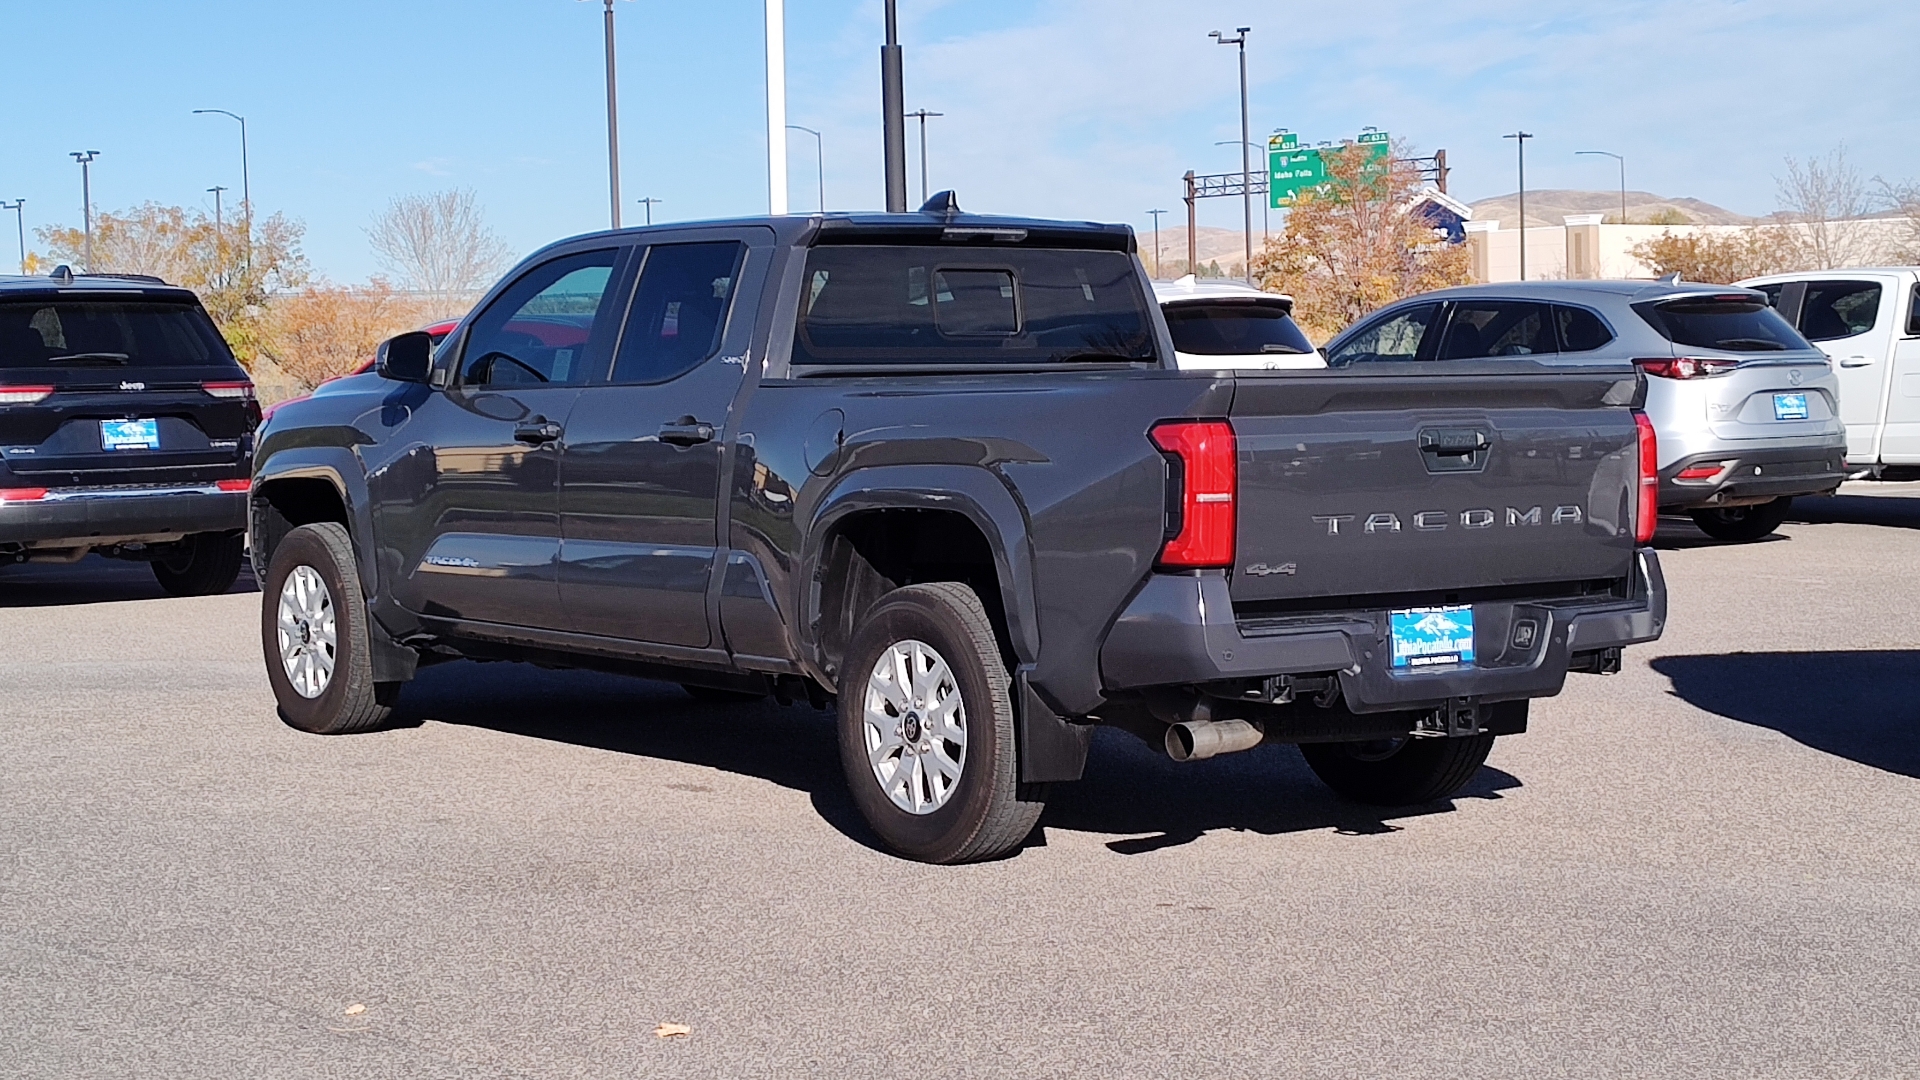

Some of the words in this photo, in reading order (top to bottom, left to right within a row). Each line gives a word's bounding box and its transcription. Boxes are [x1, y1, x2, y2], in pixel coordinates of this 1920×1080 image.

[1274, 171, 1293, 179] Idaho
[1295, 169, 1312, 178] Falls
[120, 381, 145, 390] Jeep
[1311, 505, 1583, 536] TACOMA
[1393, 635, 1473, 656] LithiaPocatello.com
